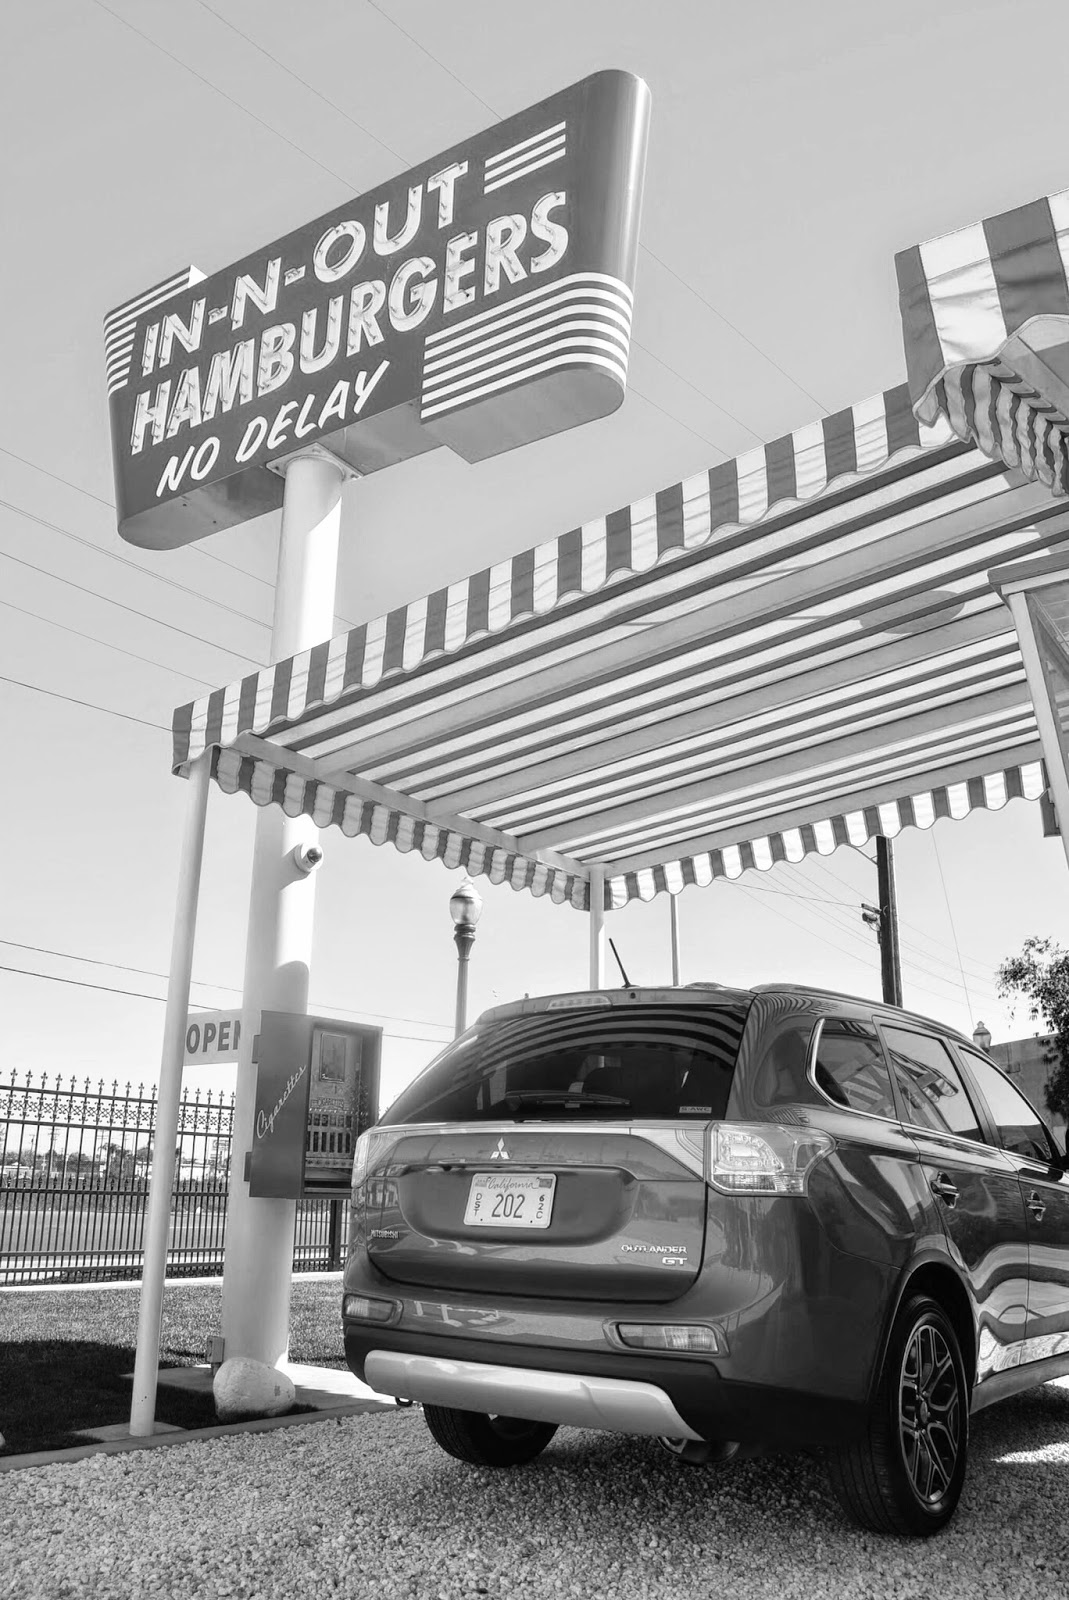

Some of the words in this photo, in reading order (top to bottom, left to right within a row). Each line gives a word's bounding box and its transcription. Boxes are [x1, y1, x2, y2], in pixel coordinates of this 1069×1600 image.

[141, 160, 468, 377] IN-N-OUT
[131, 191, 569, 455] HAMBURGERS
[155, 437, 220, 497] NO
[235, 359, 390, 463] DELAY
[257, 1065, 307, 1139] Cigarettes
[488, 1177, 539, 1193] California
[491, 1193, 525, 1219] 202
[621, 1244, 687, 1255] OUTLANDER
[662, 1257, 688, 1265] GT
